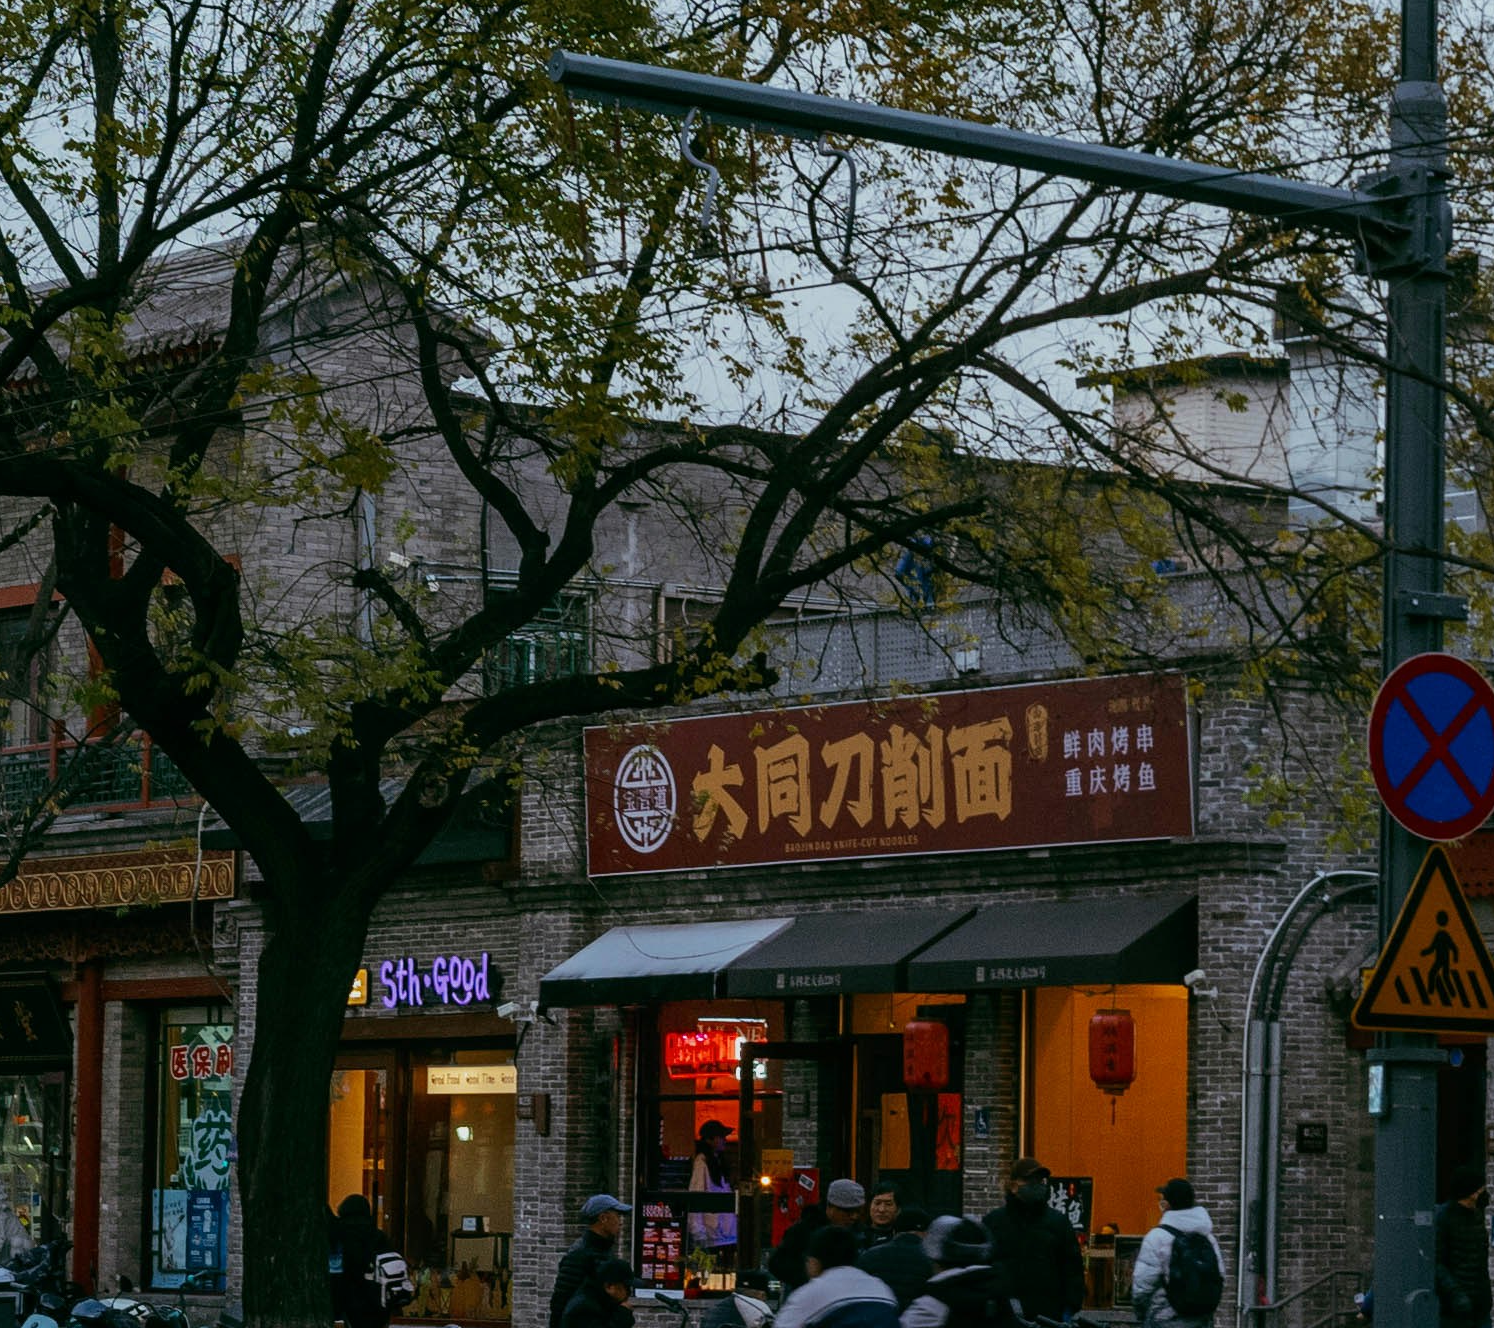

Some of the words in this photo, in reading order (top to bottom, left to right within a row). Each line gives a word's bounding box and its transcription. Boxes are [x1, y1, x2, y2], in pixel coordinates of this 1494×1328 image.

[1063, 723, 1154, 760] 鲜肉烤串
[692, 716, 1013, 843] 大同刀削面
[1065, 762, 1156, 797] 重庆烤鱼
